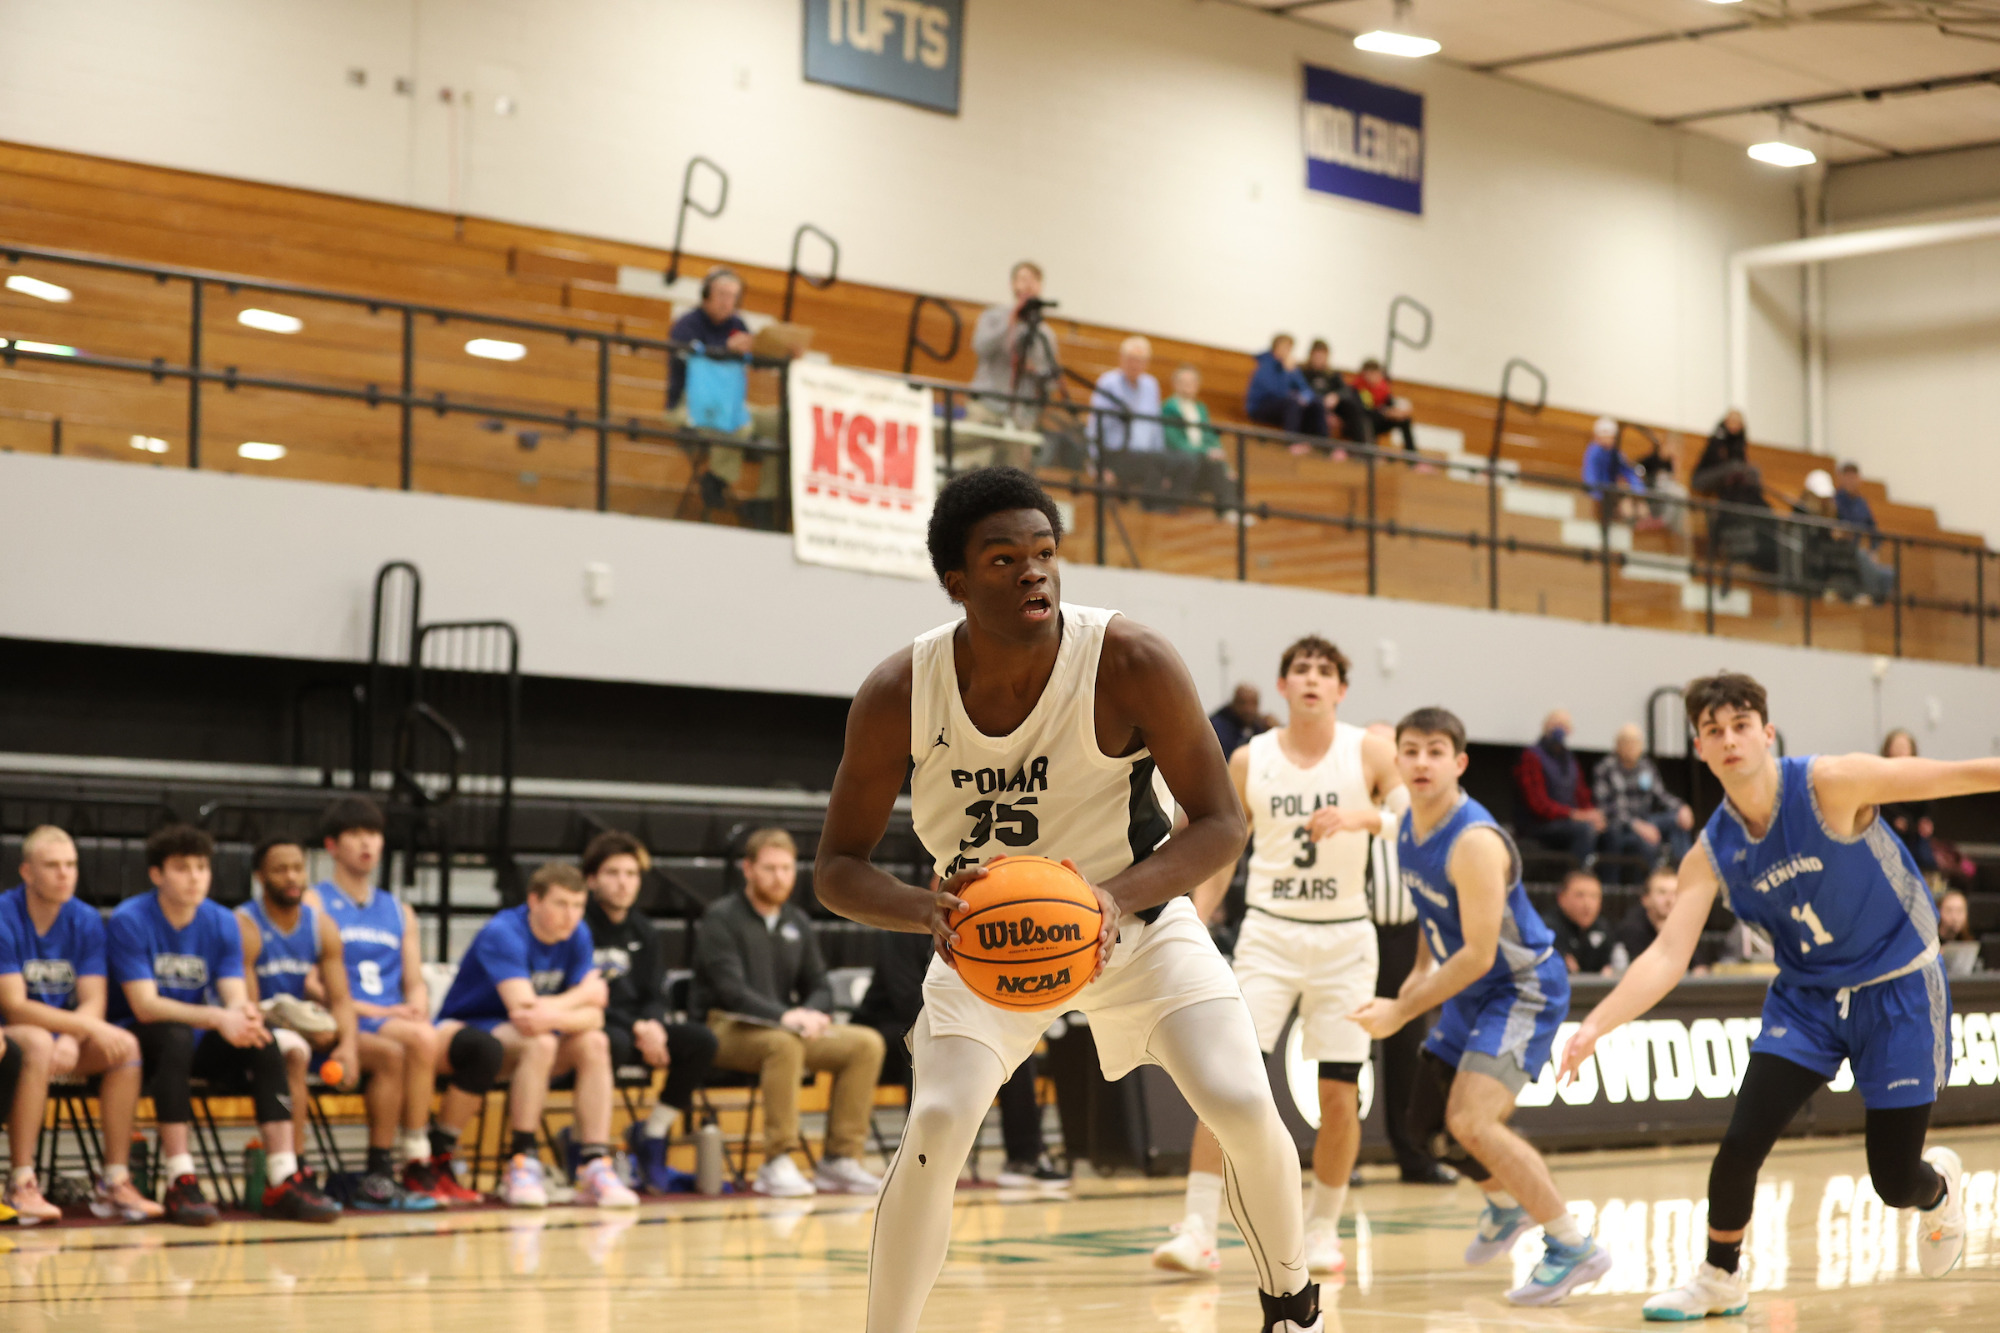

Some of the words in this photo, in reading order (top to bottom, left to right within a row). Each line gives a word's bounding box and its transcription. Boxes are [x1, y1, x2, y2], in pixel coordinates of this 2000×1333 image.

[951, 756, 1048, 795] POLAR
[1270, 792, 1338, 818] POLAR
[1292, 825, 1318, 869] 3
[1272, 878, 1338, 900] BEARS
[976, 917, 1082, 950] Wilson
[996, 968, 1071, 993] NCAA
[1515, 1017, 1763, 1107] OWDOI
